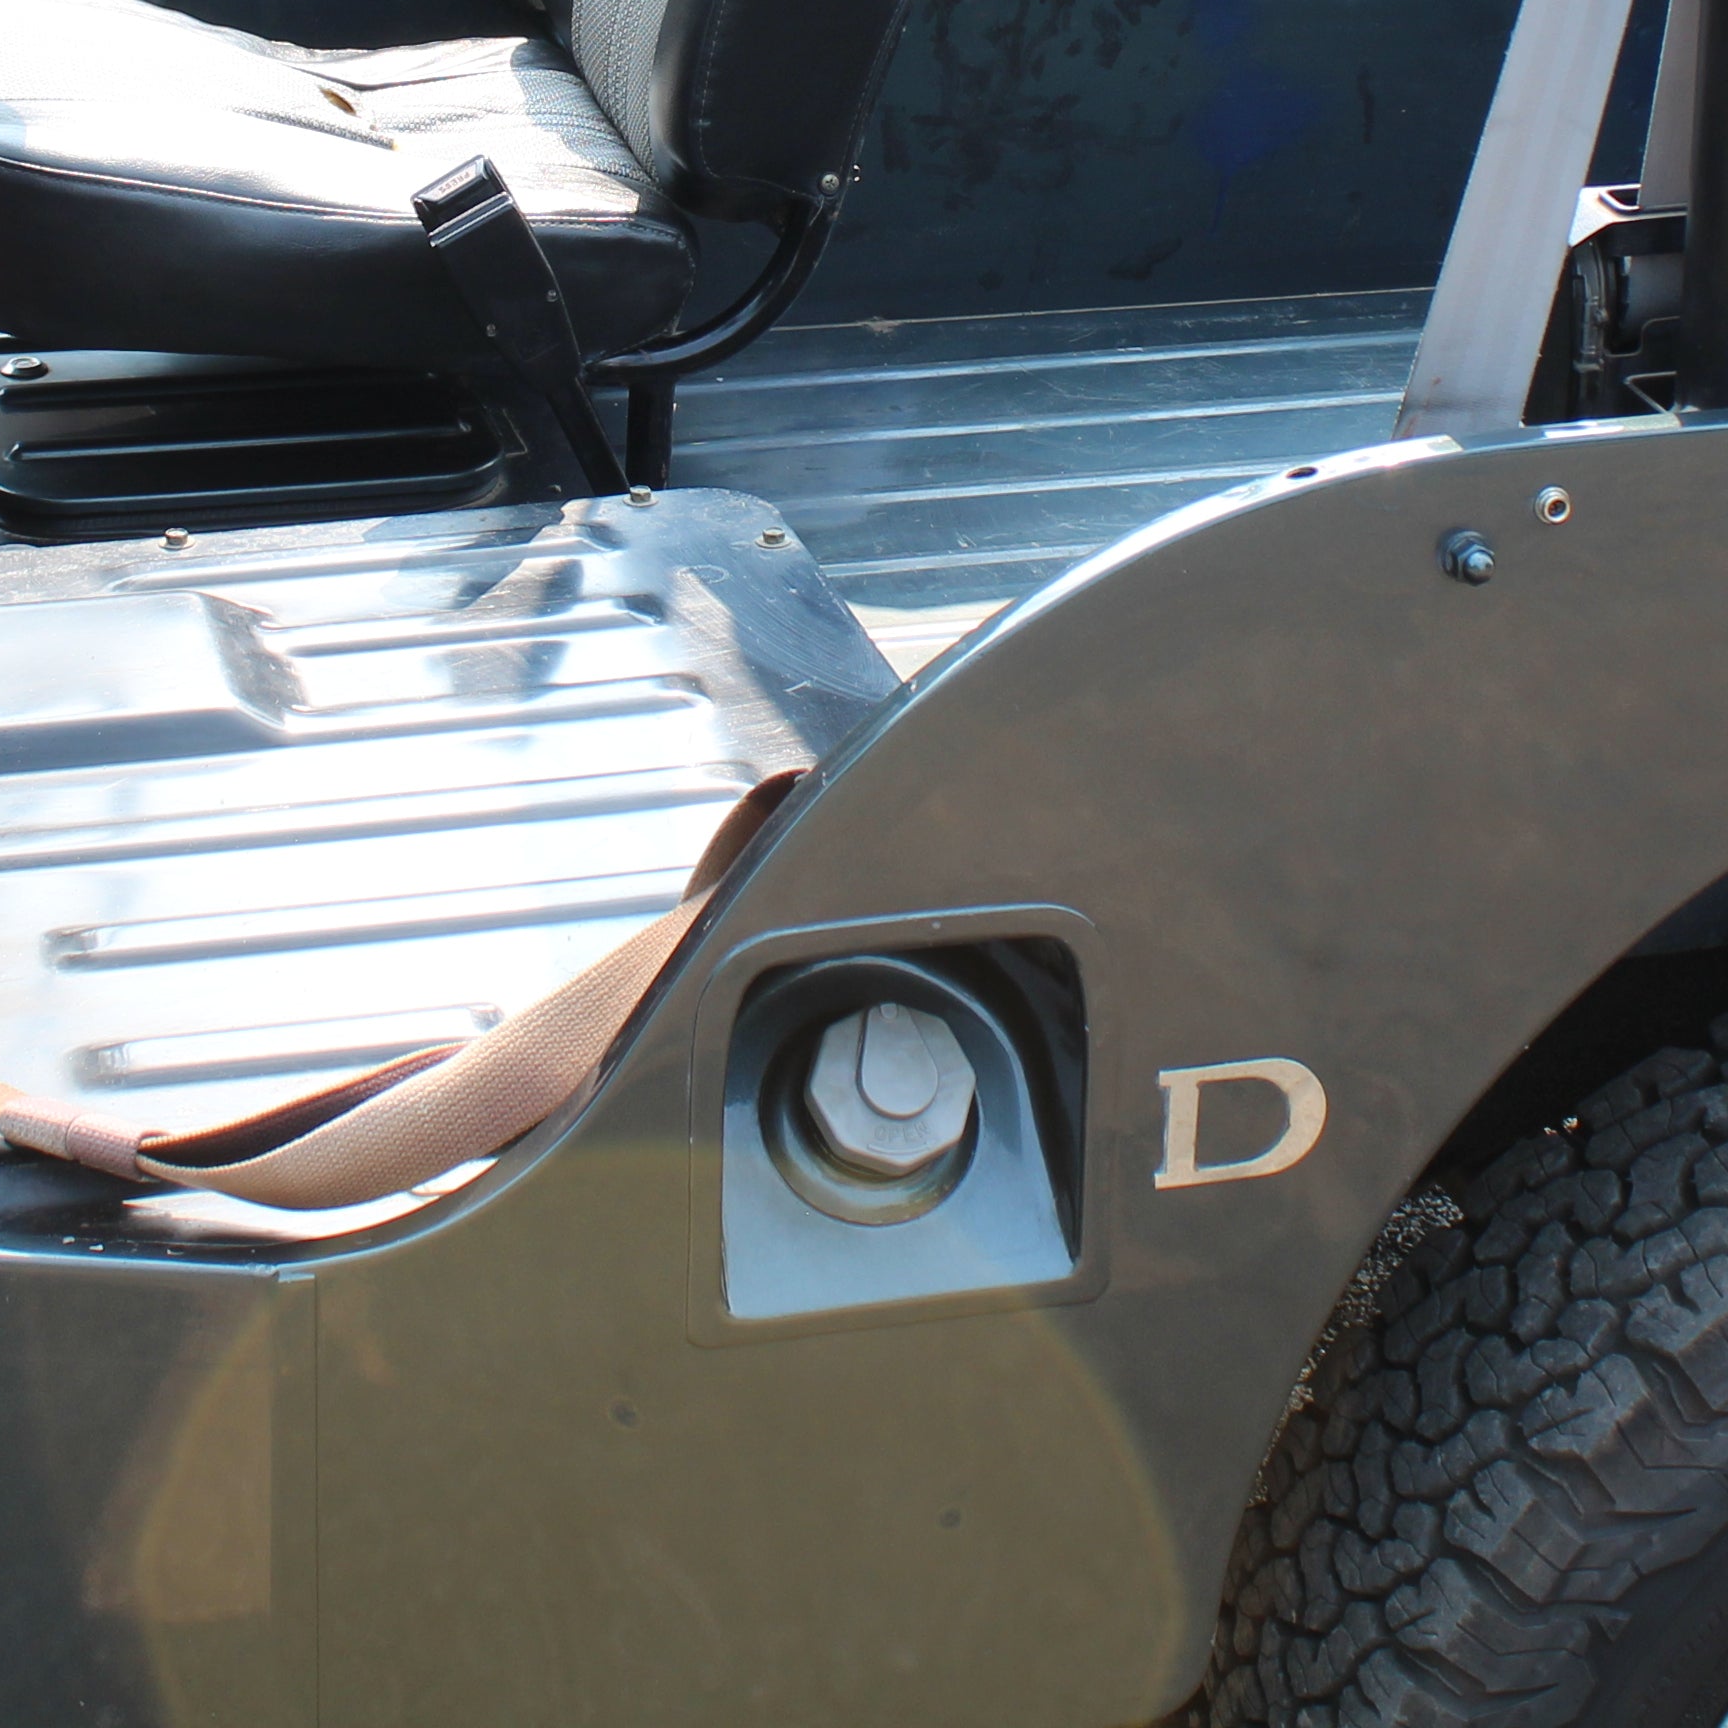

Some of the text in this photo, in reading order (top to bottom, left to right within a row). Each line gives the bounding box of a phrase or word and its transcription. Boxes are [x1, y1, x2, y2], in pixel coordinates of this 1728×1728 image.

[438, 170, 471, 193] PRESS
[872, 1121, 932, 1145] OPEN
[1153, 1056, 1329, 1190] D
